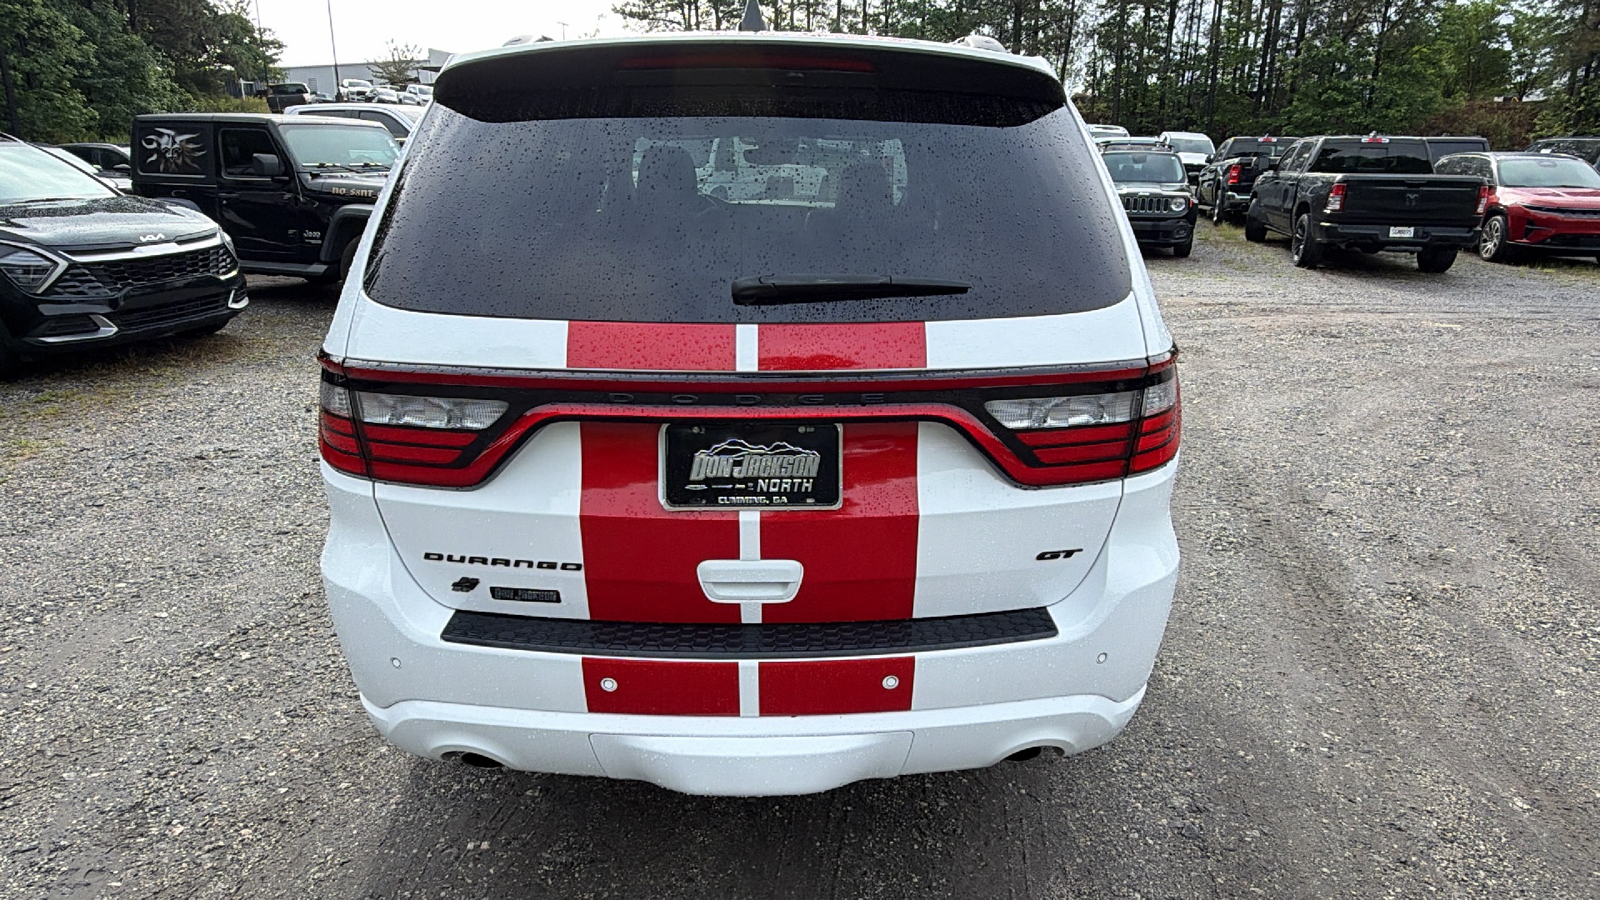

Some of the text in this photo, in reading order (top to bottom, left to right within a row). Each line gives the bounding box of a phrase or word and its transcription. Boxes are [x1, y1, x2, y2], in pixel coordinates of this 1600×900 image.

[608, 392, 885, 404] DODGE
[733, 454, 821, 478] JACKSON
[756, 479, 814, 493] NORTH
[717, 496, 788, 504] CUMMING, GA
[1036, 548, 1083, 561] GT
[423, 552, 583, 571] DURANGO
